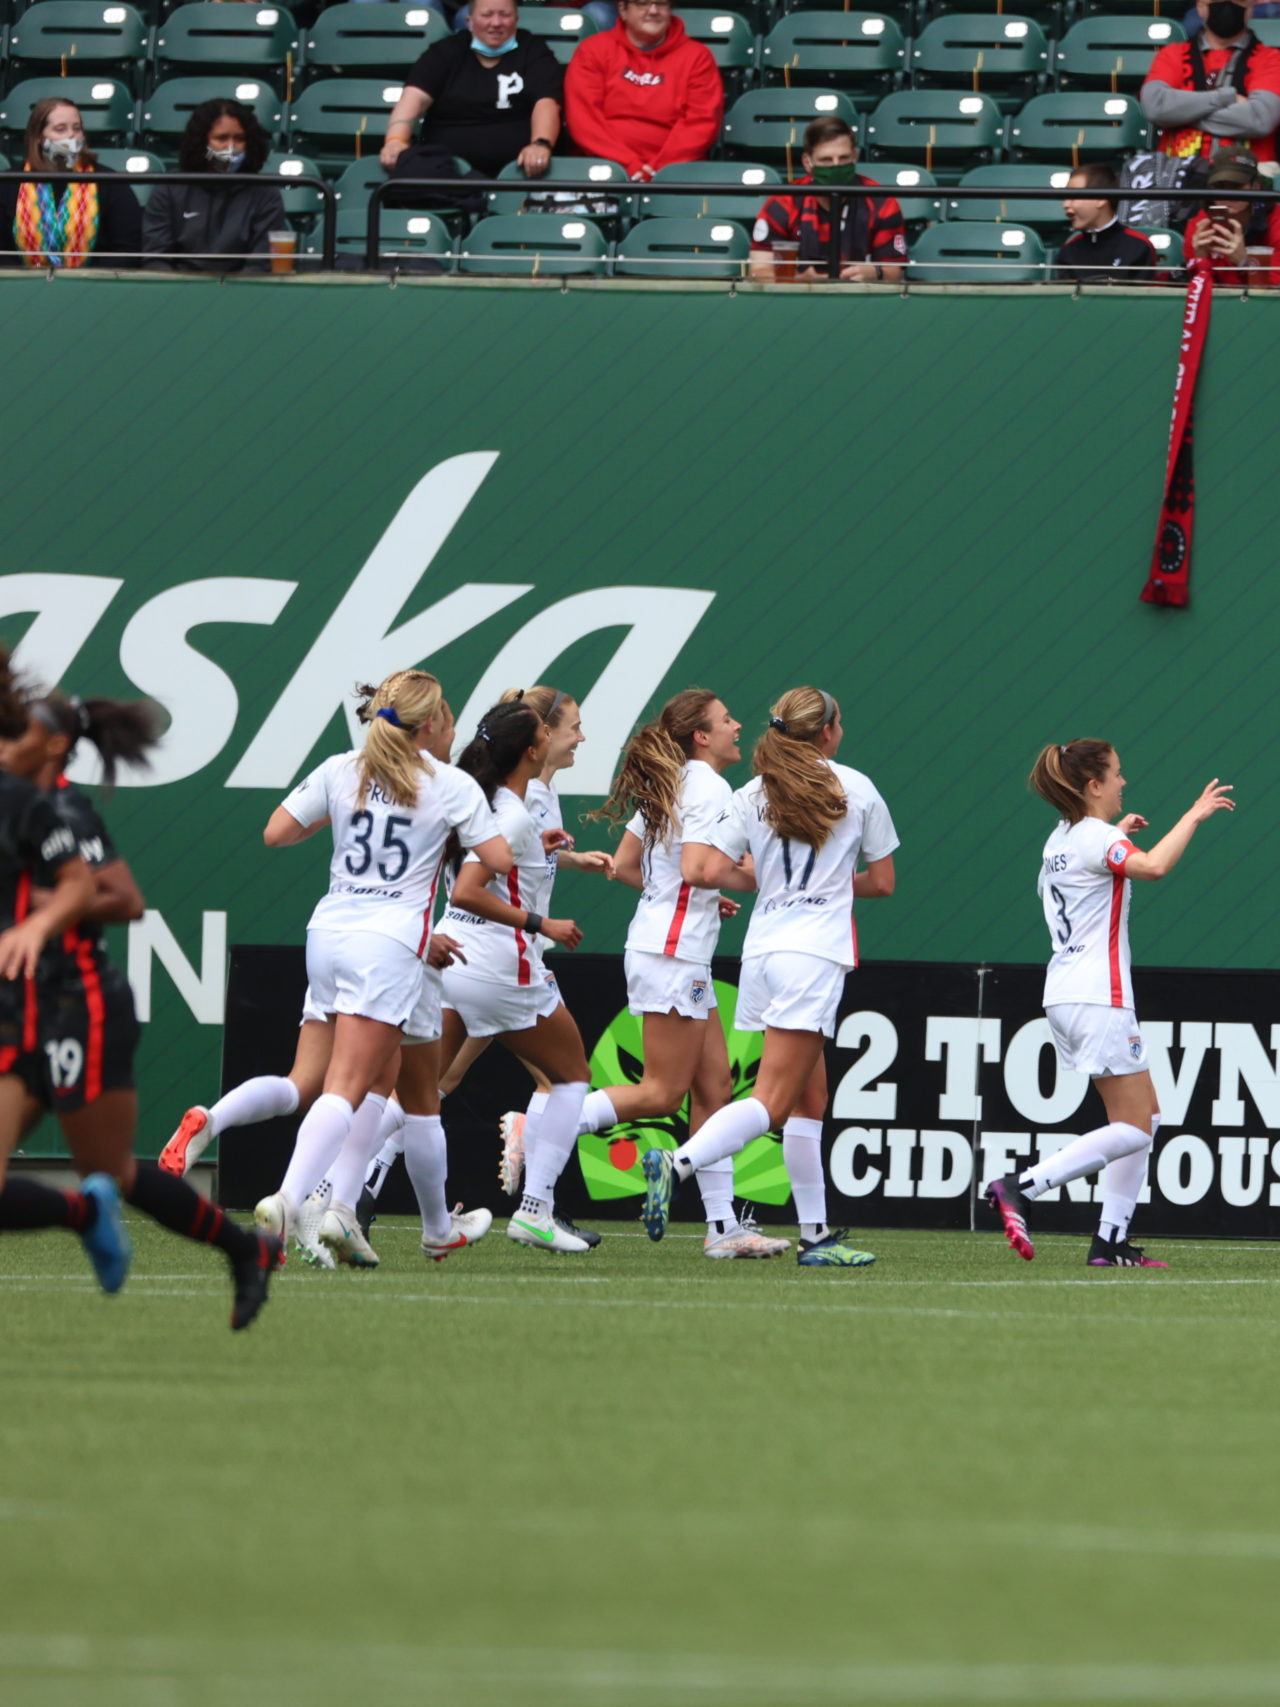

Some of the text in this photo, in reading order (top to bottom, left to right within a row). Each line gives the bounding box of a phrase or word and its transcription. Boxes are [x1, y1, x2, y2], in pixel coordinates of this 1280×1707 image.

[496, 71, 524, 109] P
[345, 809, 412, 881] 35
[1051, 884, 1072, 945] 3
[45, 1038, 83, 1088] 19
[832, 1011, 899, 1120] 2
